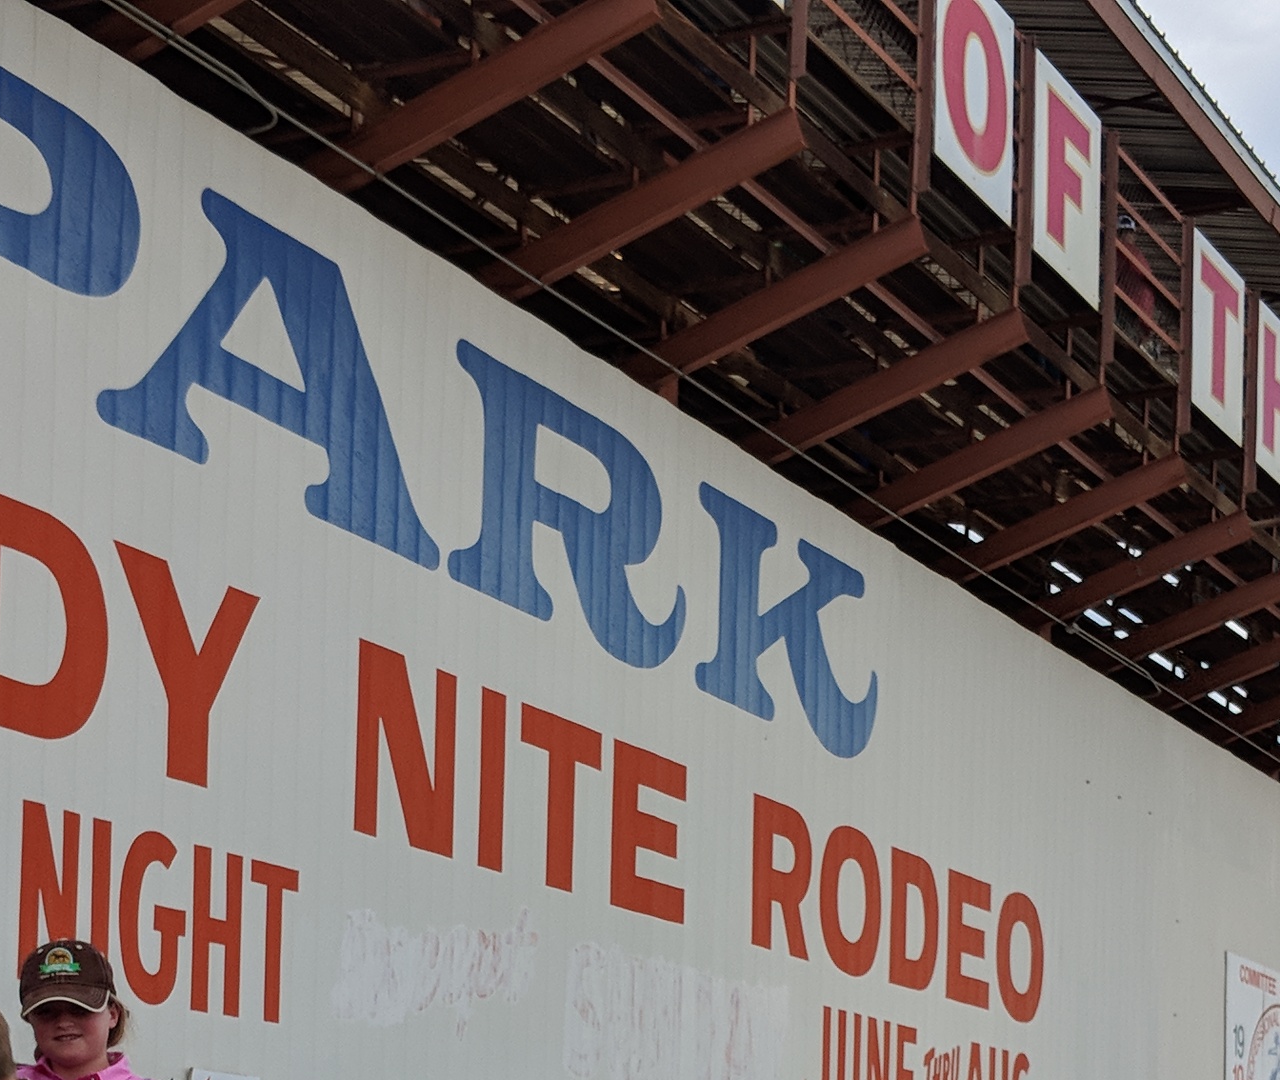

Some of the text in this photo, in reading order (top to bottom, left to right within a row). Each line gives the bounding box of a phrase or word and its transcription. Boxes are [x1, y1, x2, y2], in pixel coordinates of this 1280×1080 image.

[942, 0, 1091, 250] OF
[18, 800, 301, 1024] NIGHT
[355, 638, 687, 923] NITE
[751, 792, 1044, 1023] RODEO
[1233, 1024, 1245, 1059] 19
